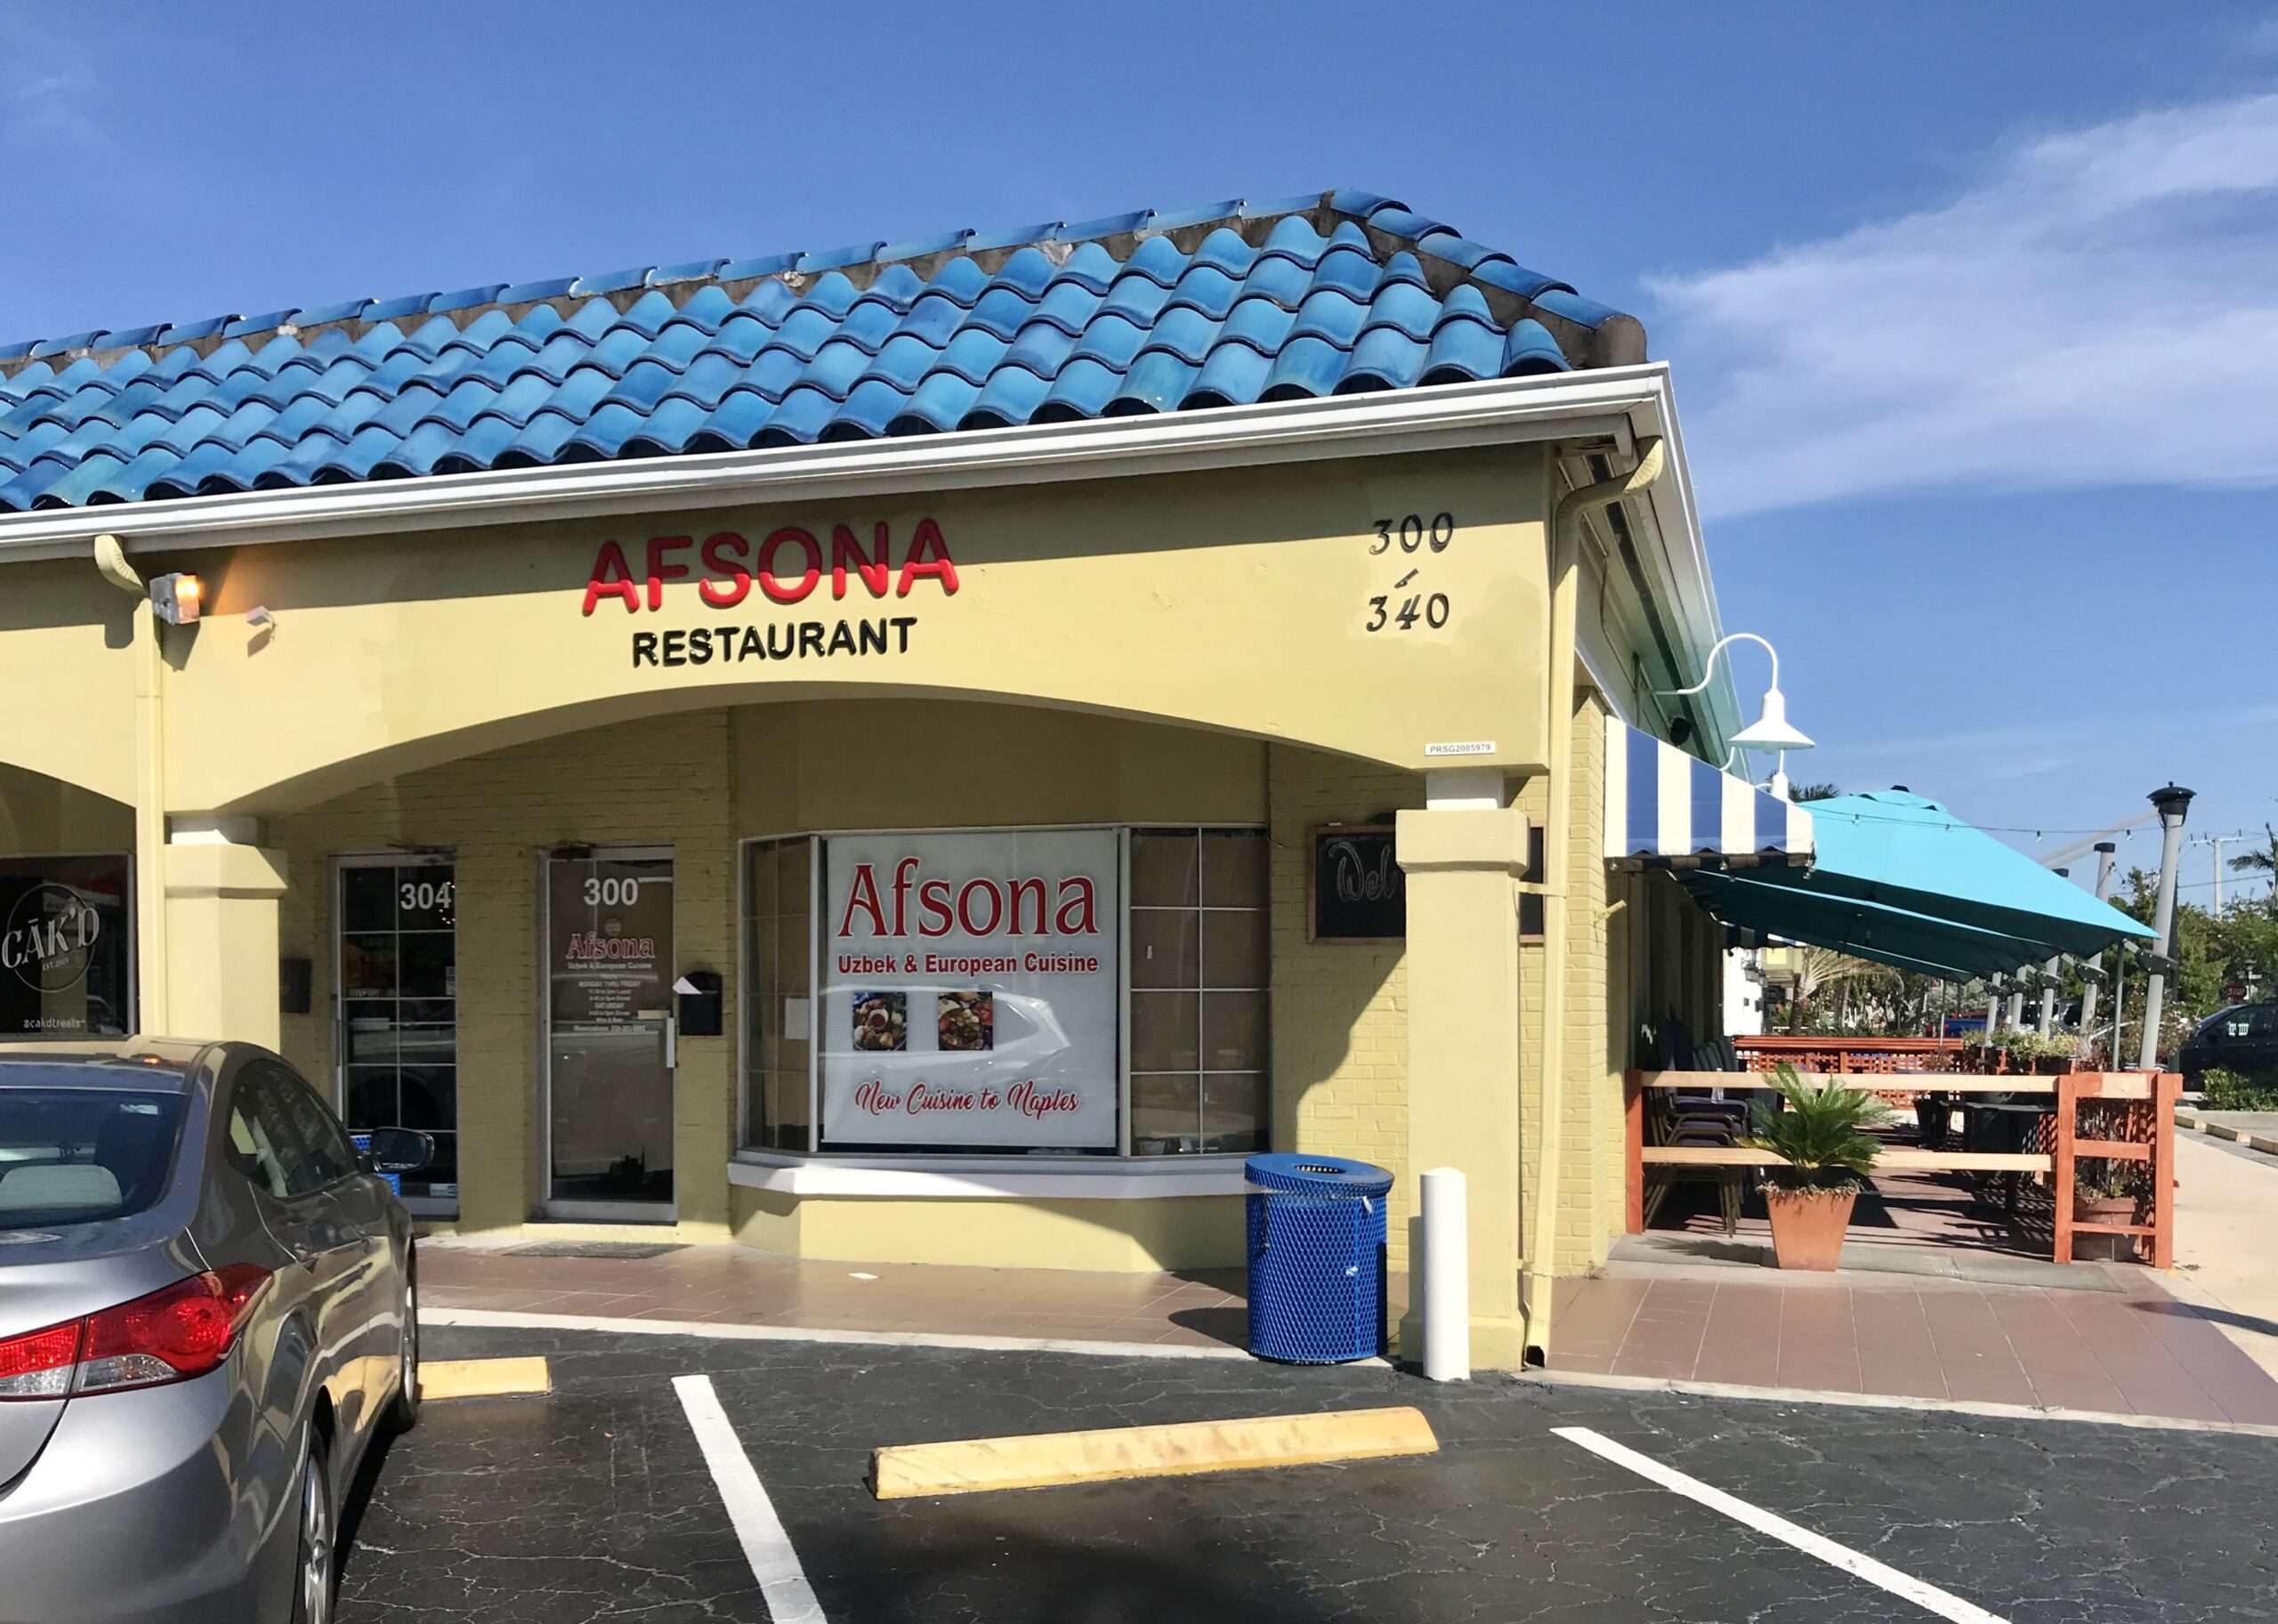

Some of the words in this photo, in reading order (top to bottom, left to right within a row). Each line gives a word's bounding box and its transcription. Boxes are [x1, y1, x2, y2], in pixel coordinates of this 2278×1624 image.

[1369, 512, 1454, 555] 300
[582, 519, 959, 617] AFSONA
[1366, 593, 1450, 632] 340
[633, 617, 917, 667] RESTAURANT
[400, 882, 451, 910] 304
[584, 877, 639, 906] 300
[836, 856, 1100, 938] Afsona
[566, 932, 656, 959] Afsona
[837, 954, 896, 974] Uzbek
[904, 955, 917, 973] &
[925, 953, 1017, 976] European
[1024, 952, 1099, 974] Cuisine
[854, 1079, 901, 1118] New
[906, 1081, 975, 1115] Cuisine
[981, 1085, 1001, 1111] to
[1006, 1079, 1079, 1120] Naples
